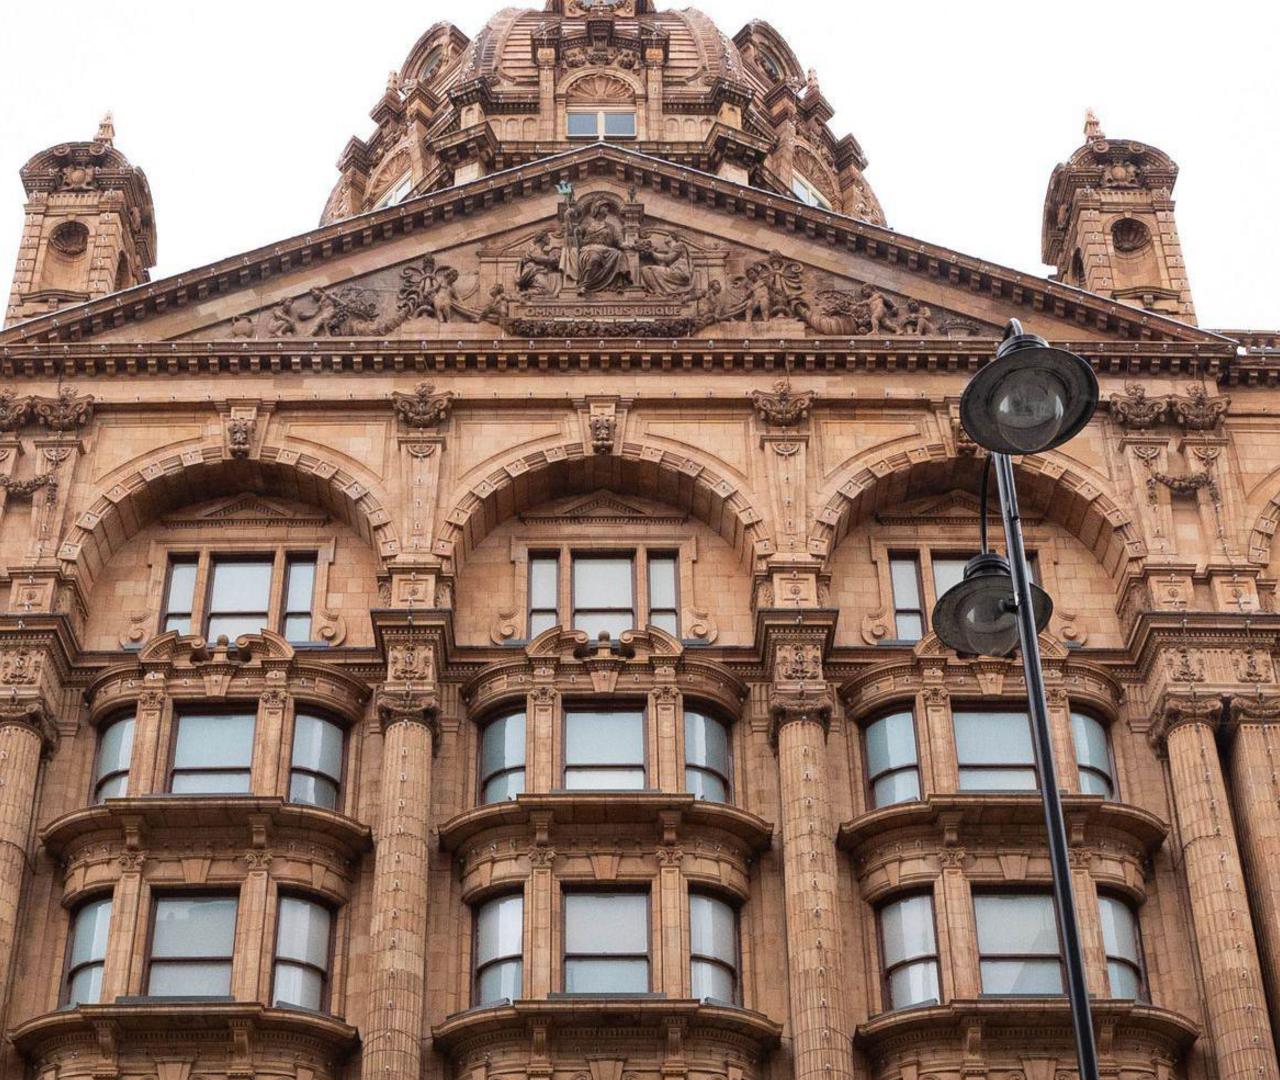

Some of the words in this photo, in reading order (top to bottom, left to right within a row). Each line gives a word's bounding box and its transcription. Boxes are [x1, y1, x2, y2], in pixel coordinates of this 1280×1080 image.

[525, 306, 567, 317] OMNIA
[574, 306, 631, 316] OMNIBUS
[634, 306, 681, 316] UBIQUE
